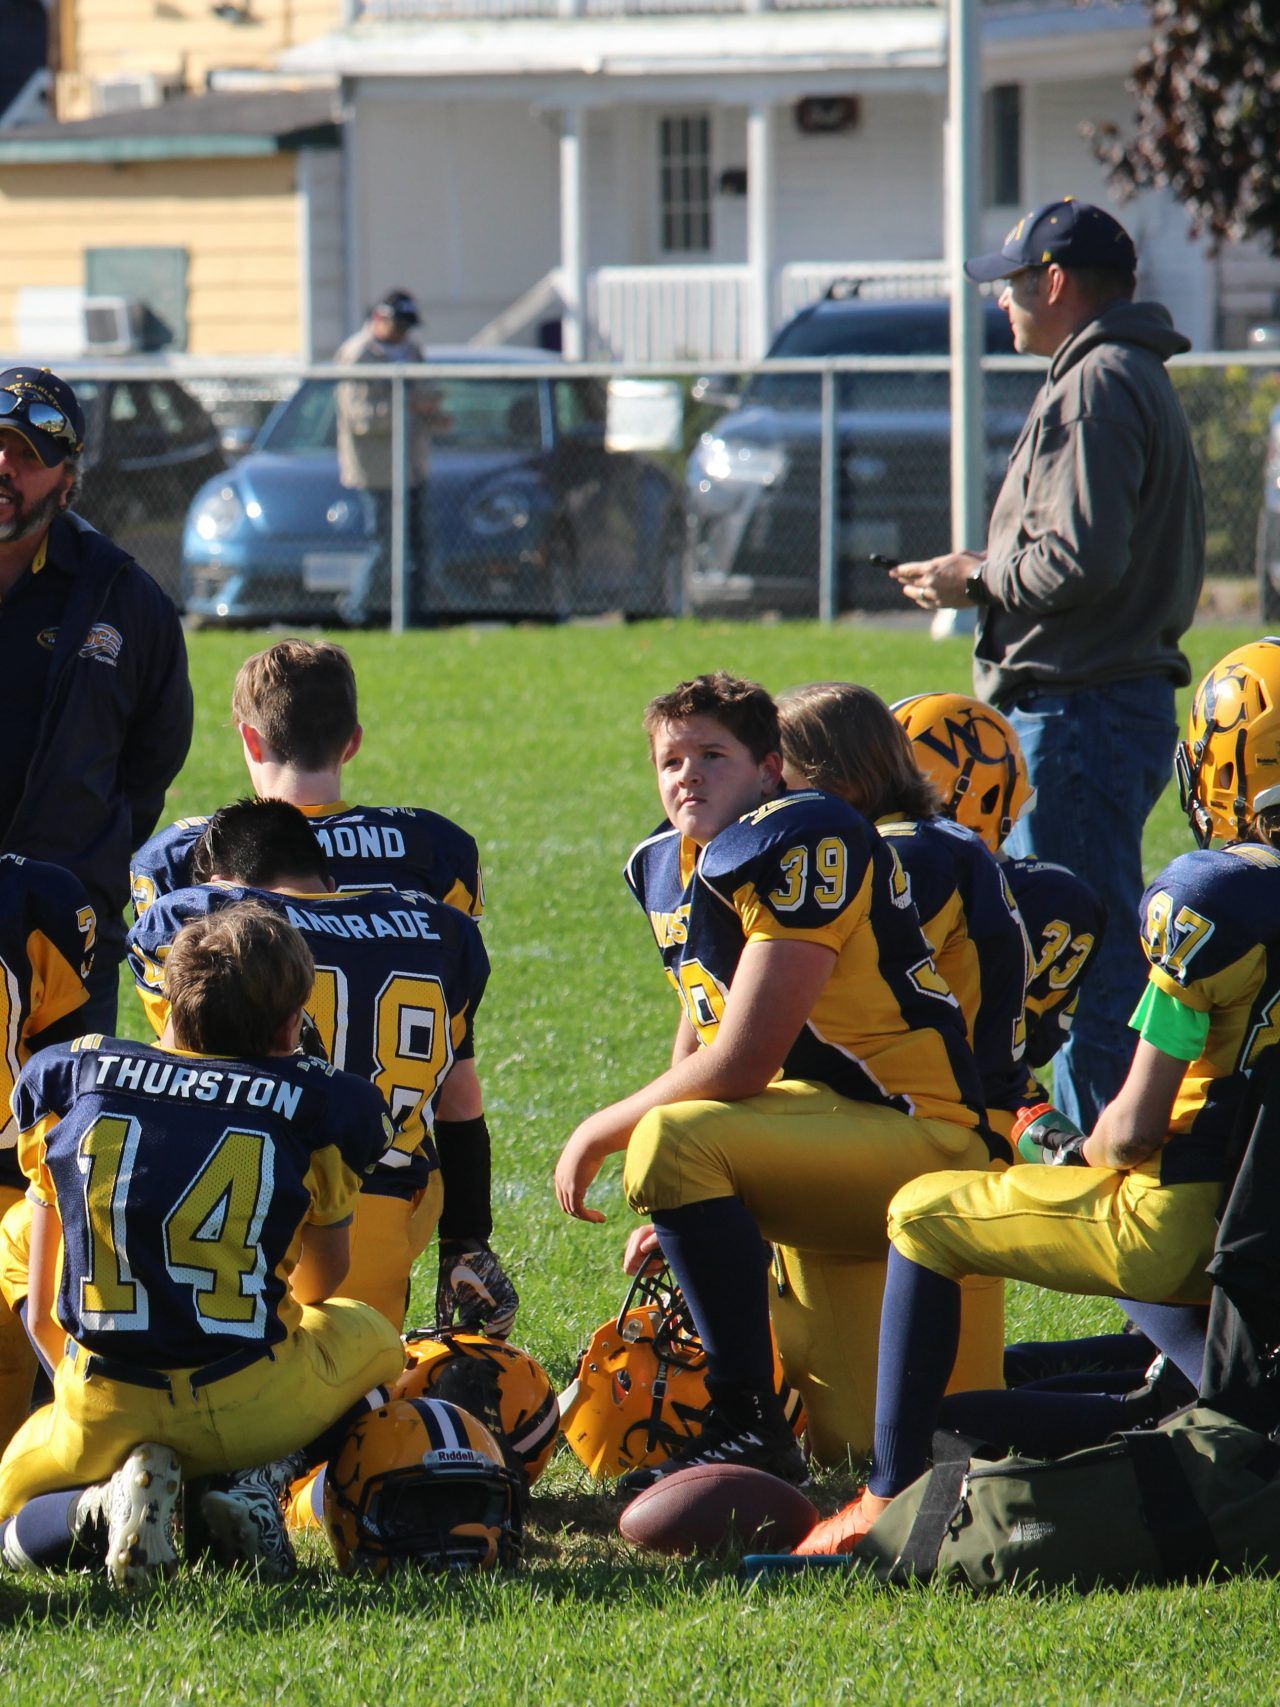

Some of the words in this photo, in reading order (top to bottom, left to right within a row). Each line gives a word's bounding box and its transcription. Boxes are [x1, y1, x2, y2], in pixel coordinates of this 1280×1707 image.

[313, 825, 407, 858] MOND
[768, 836, 849, 912] 39
[284, 905, 442, 942] ANDRADE
[1144, 889, 1217, 981] 87
[95, 1055, 304, 1121] THURSTON
[76, 1111, 277, 1340] 14
[437, 1450, 475, 1462] Riddell
